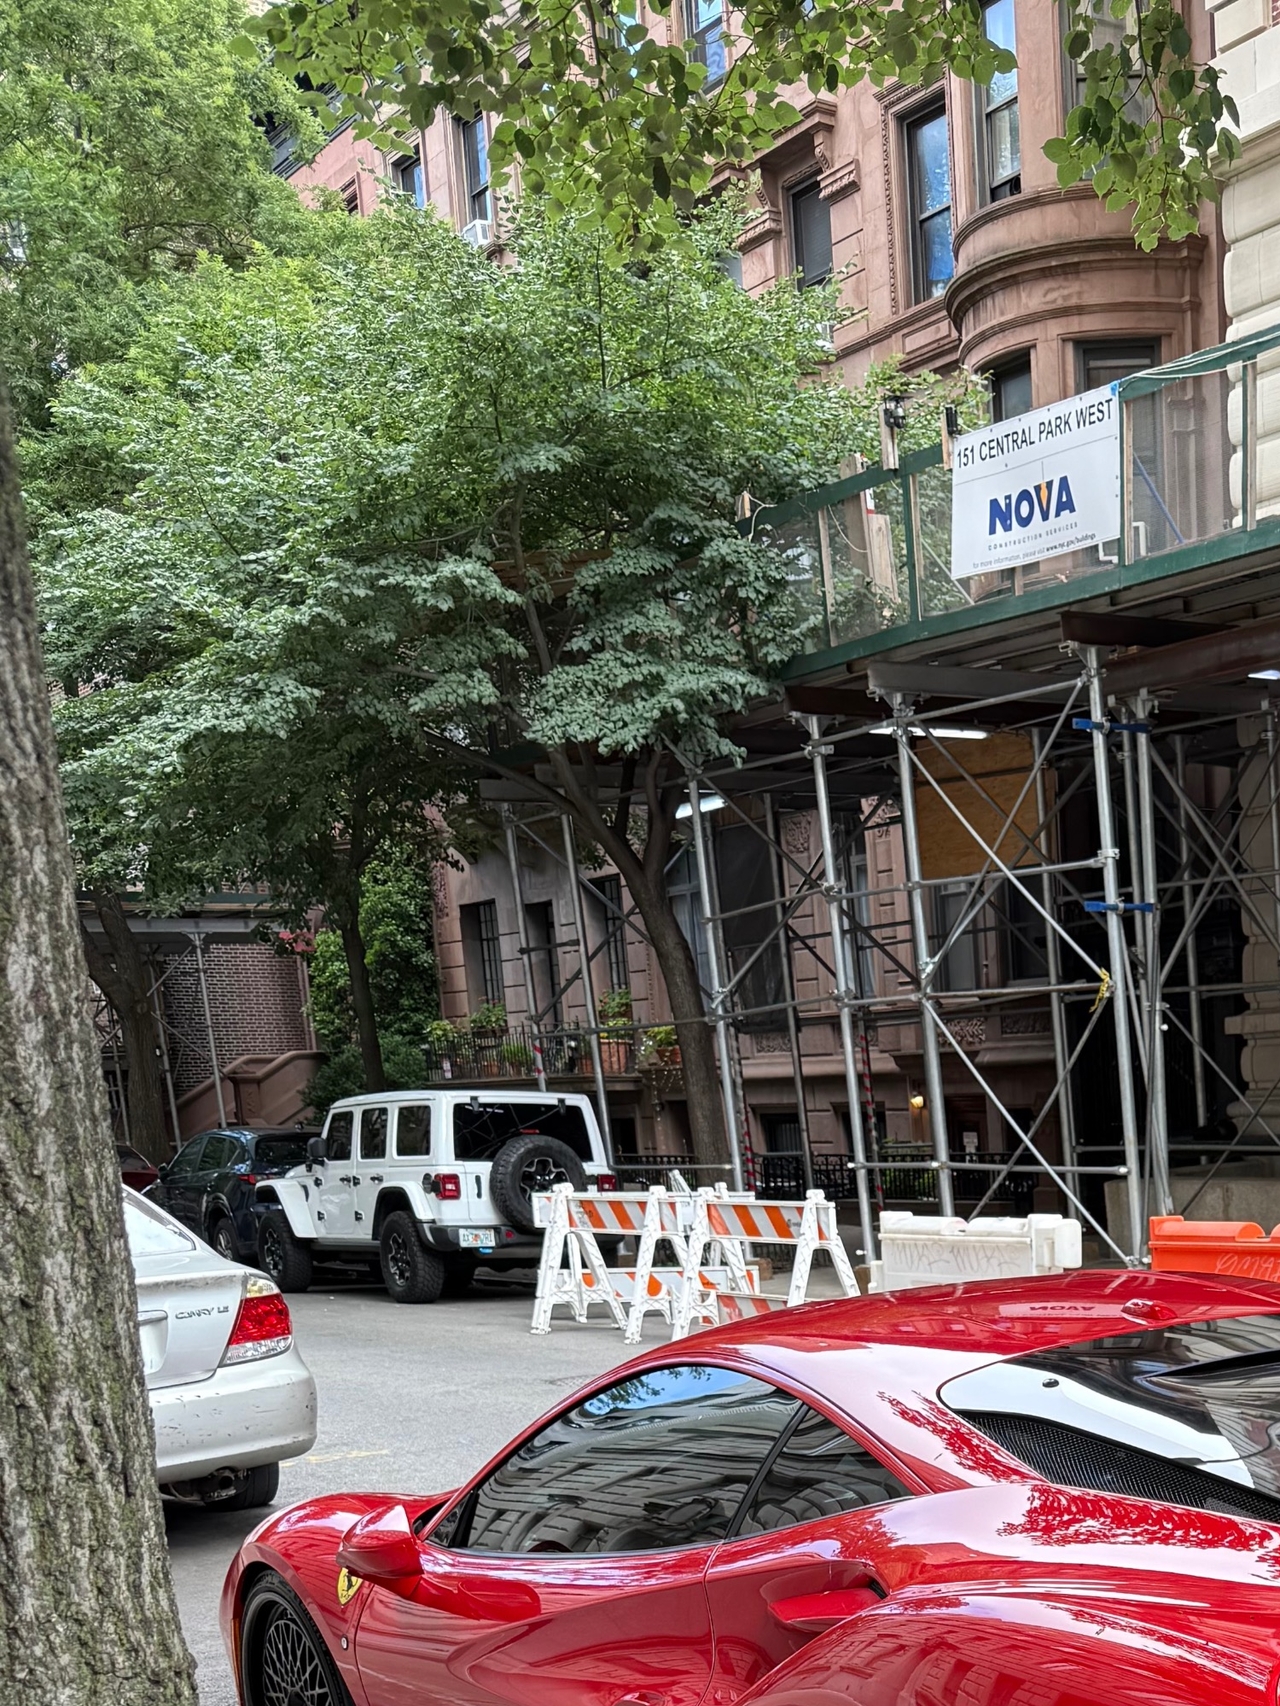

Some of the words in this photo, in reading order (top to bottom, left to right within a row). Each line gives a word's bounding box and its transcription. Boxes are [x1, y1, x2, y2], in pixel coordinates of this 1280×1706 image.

[957, 445, 975, 468] 151
[979, 426, 1035, 461] CENTRAL
[1038, 412, 1072, 442] PARK
[1076, 398, 1113, 429] WEST
[988, 475, 1076, 536] NOVA
[988, 533, 1042, 551] CONSTRUCTION
[1046, 521, 1078, 537] SERVICES
